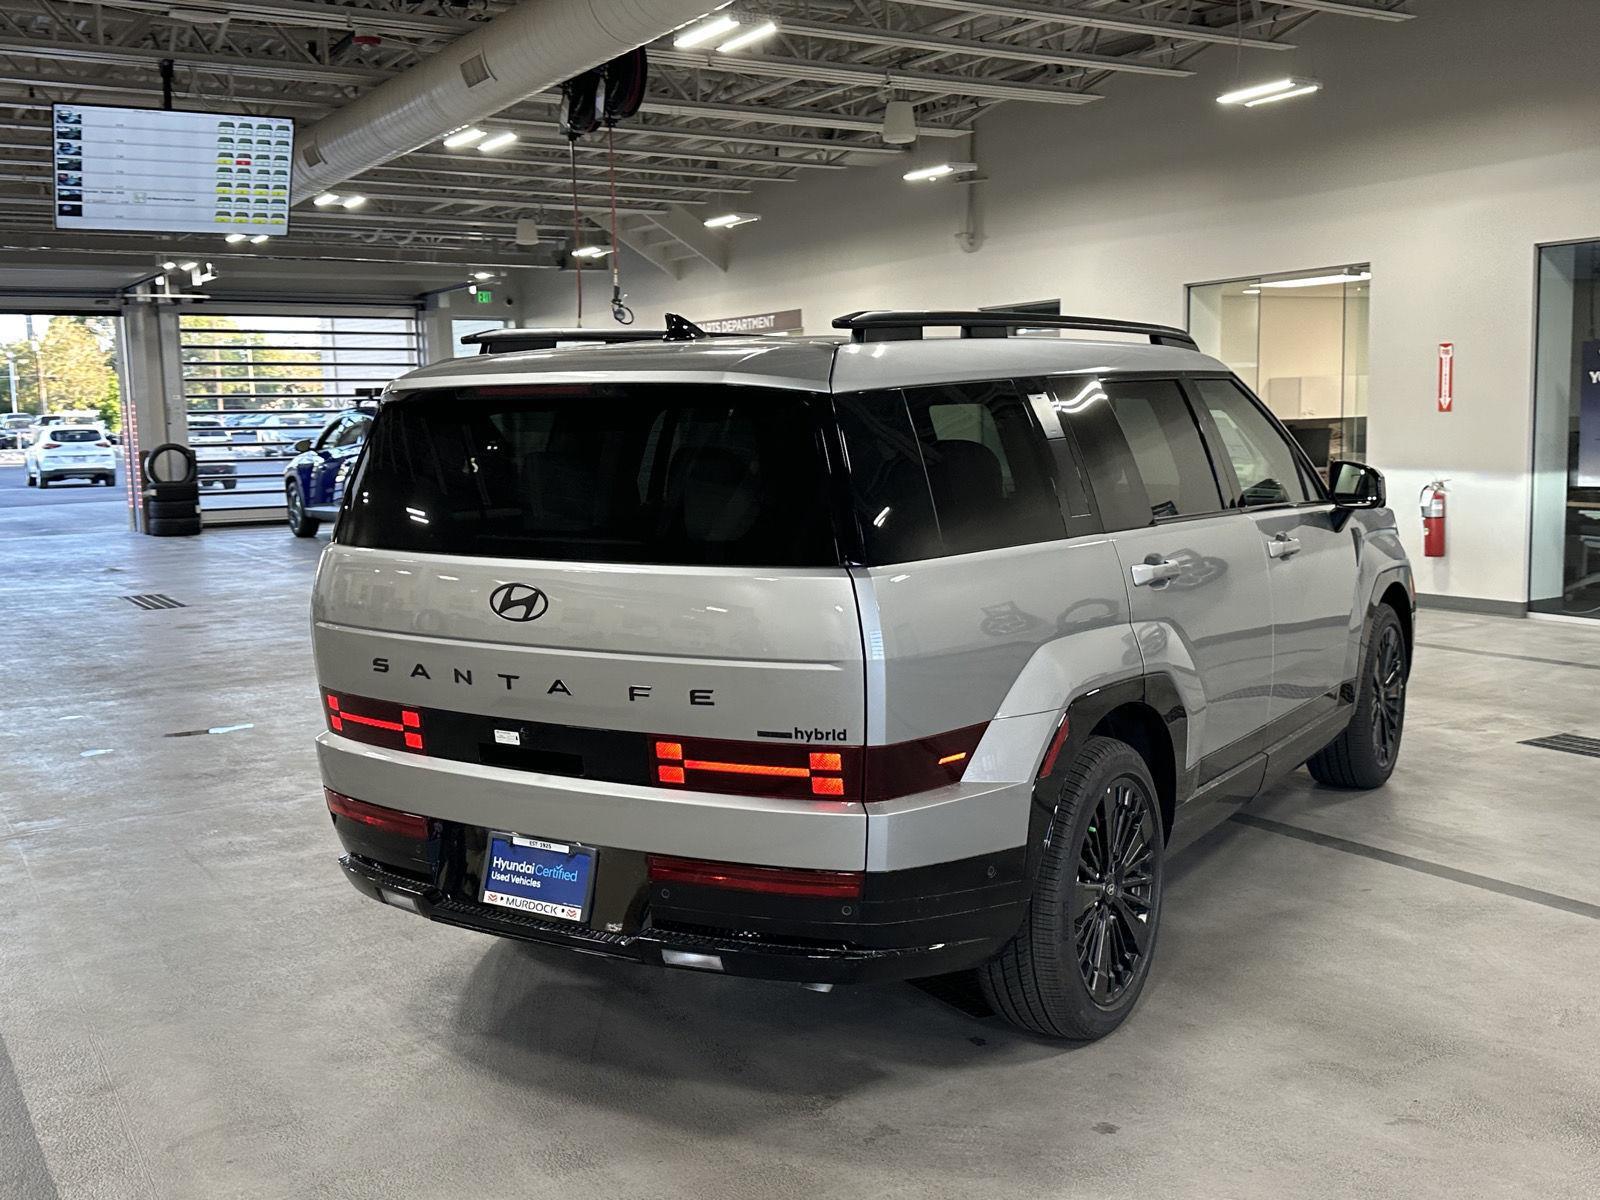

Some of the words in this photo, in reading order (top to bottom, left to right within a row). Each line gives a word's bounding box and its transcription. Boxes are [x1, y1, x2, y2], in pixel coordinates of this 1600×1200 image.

[721, 315, 775, 332] DEPARTMENT
[372, 657, 573, 696] SANTA
[628, 684, 715, 706] FE
[794, 726, 847, 743] hybrid
[492, 856, 535, 874] Hyundai
[535, 864, 578, 882] Certified
[491, 871, 510, 882] Used
[511, 874, 541, 888] Vehicles
[505, 896, 558, 915] MURDOCK
